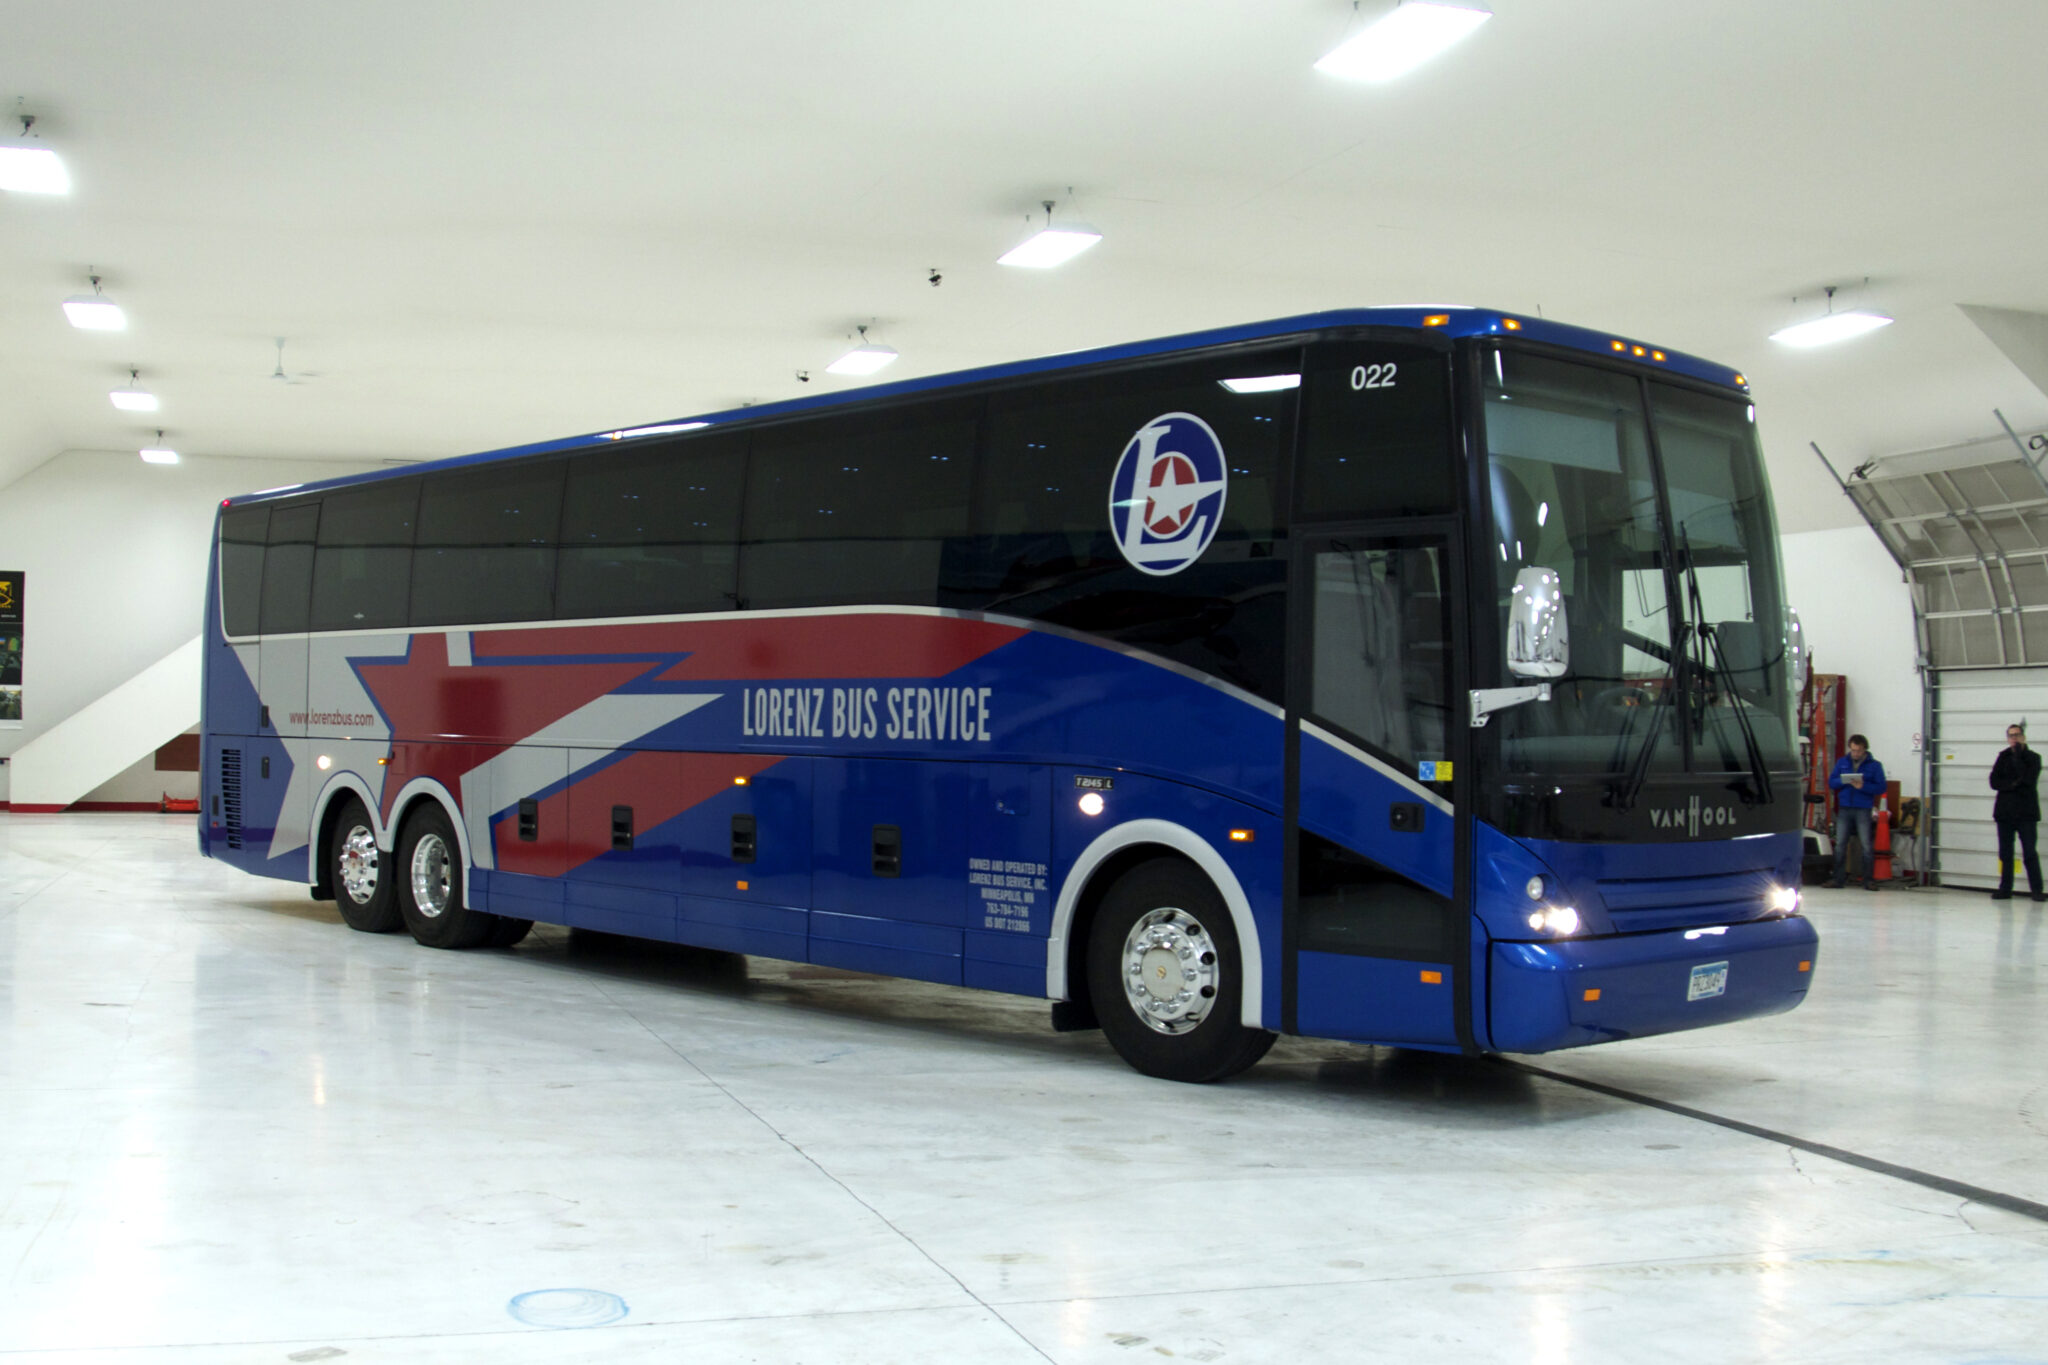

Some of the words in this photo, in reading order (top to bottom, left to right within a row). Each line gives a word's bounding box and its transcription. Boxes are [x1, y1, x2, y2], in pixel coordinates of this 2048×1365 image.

[1351, 362, 1397, 390] 022
[289, 708, 374, 727] www.lorenzbus.com
[743, 687, 825, 738] LORENZ
[832, 686, 878, 739] BUS
[885, 686, 992, 742] SERVICE
[969, 858, 990, 870] OWNED
[992, 860, 1004, 872] AND
[1005, 861, 1035, 875] OPERATED
[969, 872, 991, 885] LORENZ
[993, 874, 1004, 886] BUS
